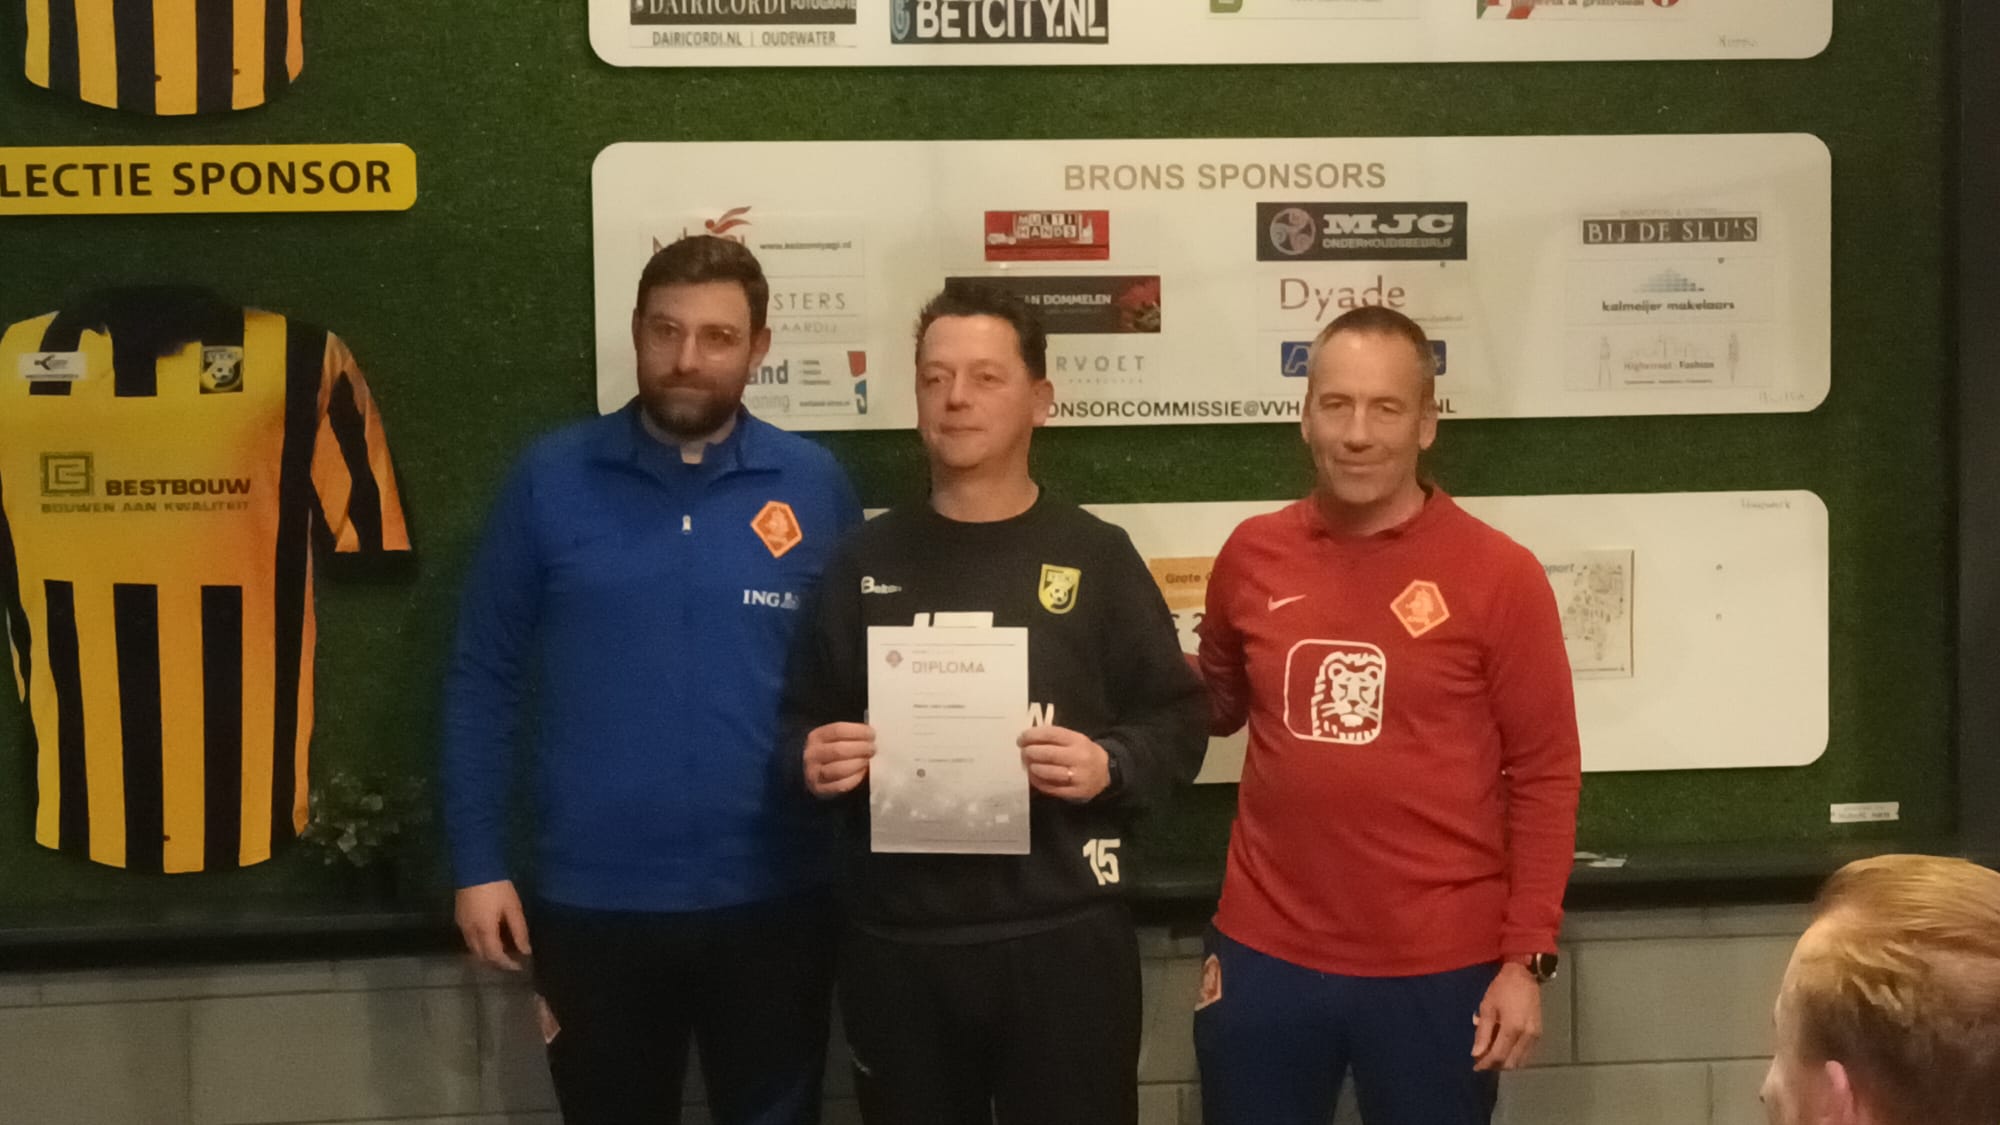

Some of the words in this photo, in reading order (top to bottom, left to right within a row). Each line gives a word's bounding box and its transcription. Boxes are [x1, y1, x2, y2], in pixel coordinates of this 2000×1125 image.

[762, 31, 836, 46] OUDEWATER
[0, 163, 152, 198] LECTIE
[173, 160, 391, 196] SPONSOR
[1064, 164, 1185, 191] BRONS
[1198, 163, 1386, 190] SPONSORS
[1018, 226, 1077, 238] HANDS
[1323, 214, 1454, 234] MJC
[1588, 222, 1627, 243] BIJ
[1639, 222, 1671, 241] DE
[1682, 219, 1755, 241] SLU'S
[773, 292, 846, 311] STERS
[1280, 275, 1406, 322] Dyade
[1602, 301, 1662, 315] kalmeijer
[1667, 299, 1735, 311] makelaars
[1056, 354, 1145, 372] RVOET
[1048, 400, 1300, 418] ONSORCOMMISSIE@VVH
[106, 478, 251, 497] BESTBOUW
[41, 502, 115, 513] BOUWEN
[123, 502, 156, 512] AAN
[165, 501, 249, 512] KWALITEIT
[743, 589, 780, 608] ING
[912, 660, 985, 674] DIPLOMA
